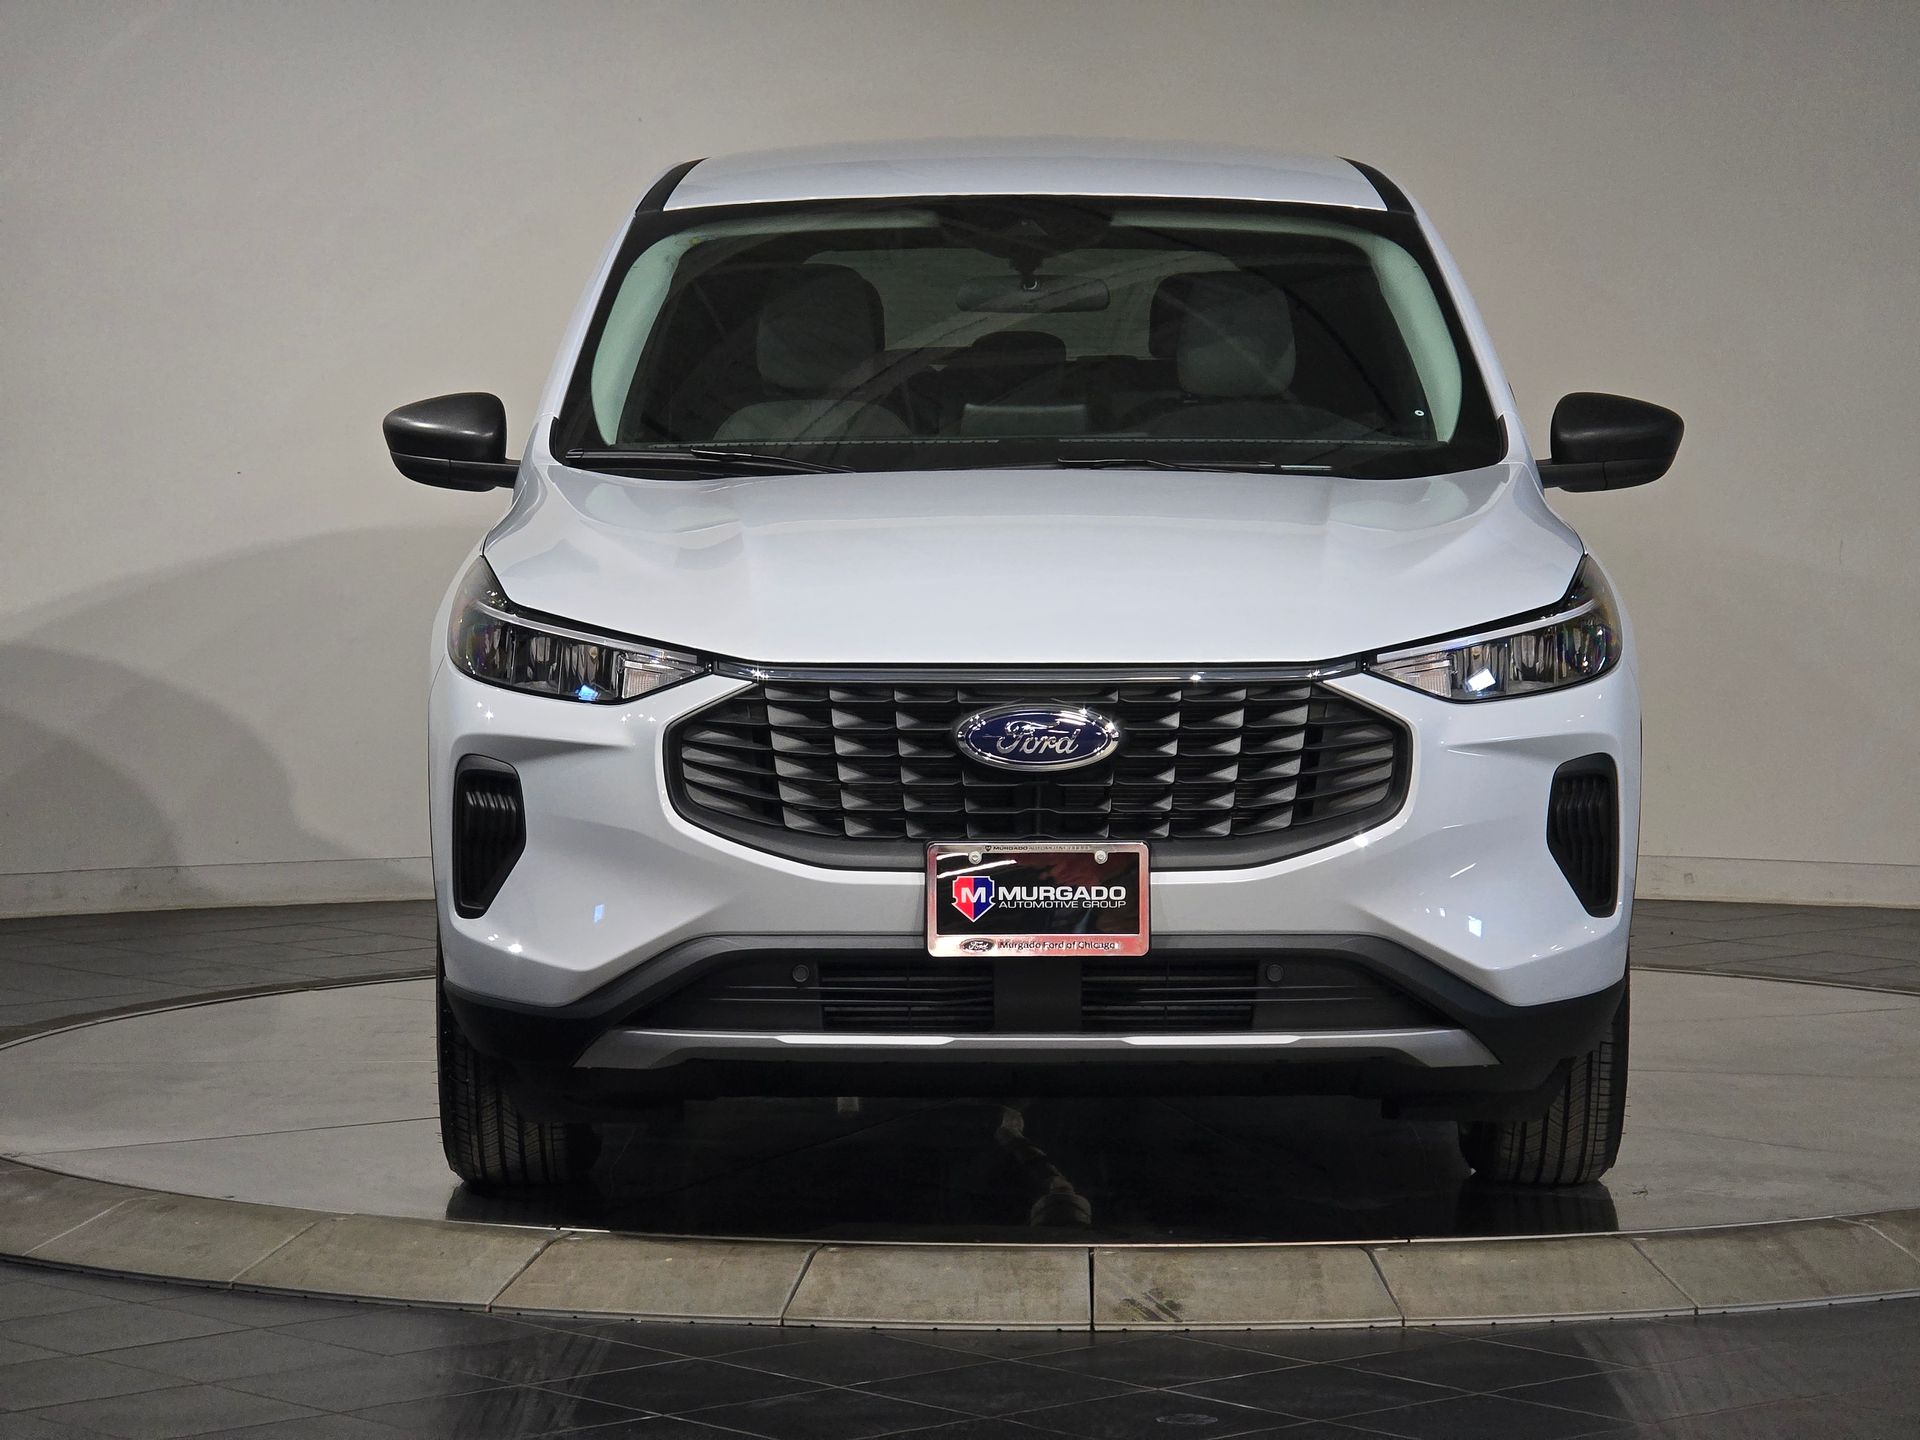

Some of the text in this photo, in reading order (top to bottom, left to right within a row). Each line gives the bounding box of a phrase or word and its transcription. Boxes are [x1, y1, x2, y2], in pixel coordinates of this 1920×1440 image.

[995, 720, 1081, 755] Ford
[999, 886, 1126, 901] MURGADO
[999, 901, 1126, 909] AUTOMOTIVE GROUP
[1000, 941, 1116, 951] Murgado Ford of Chicago
